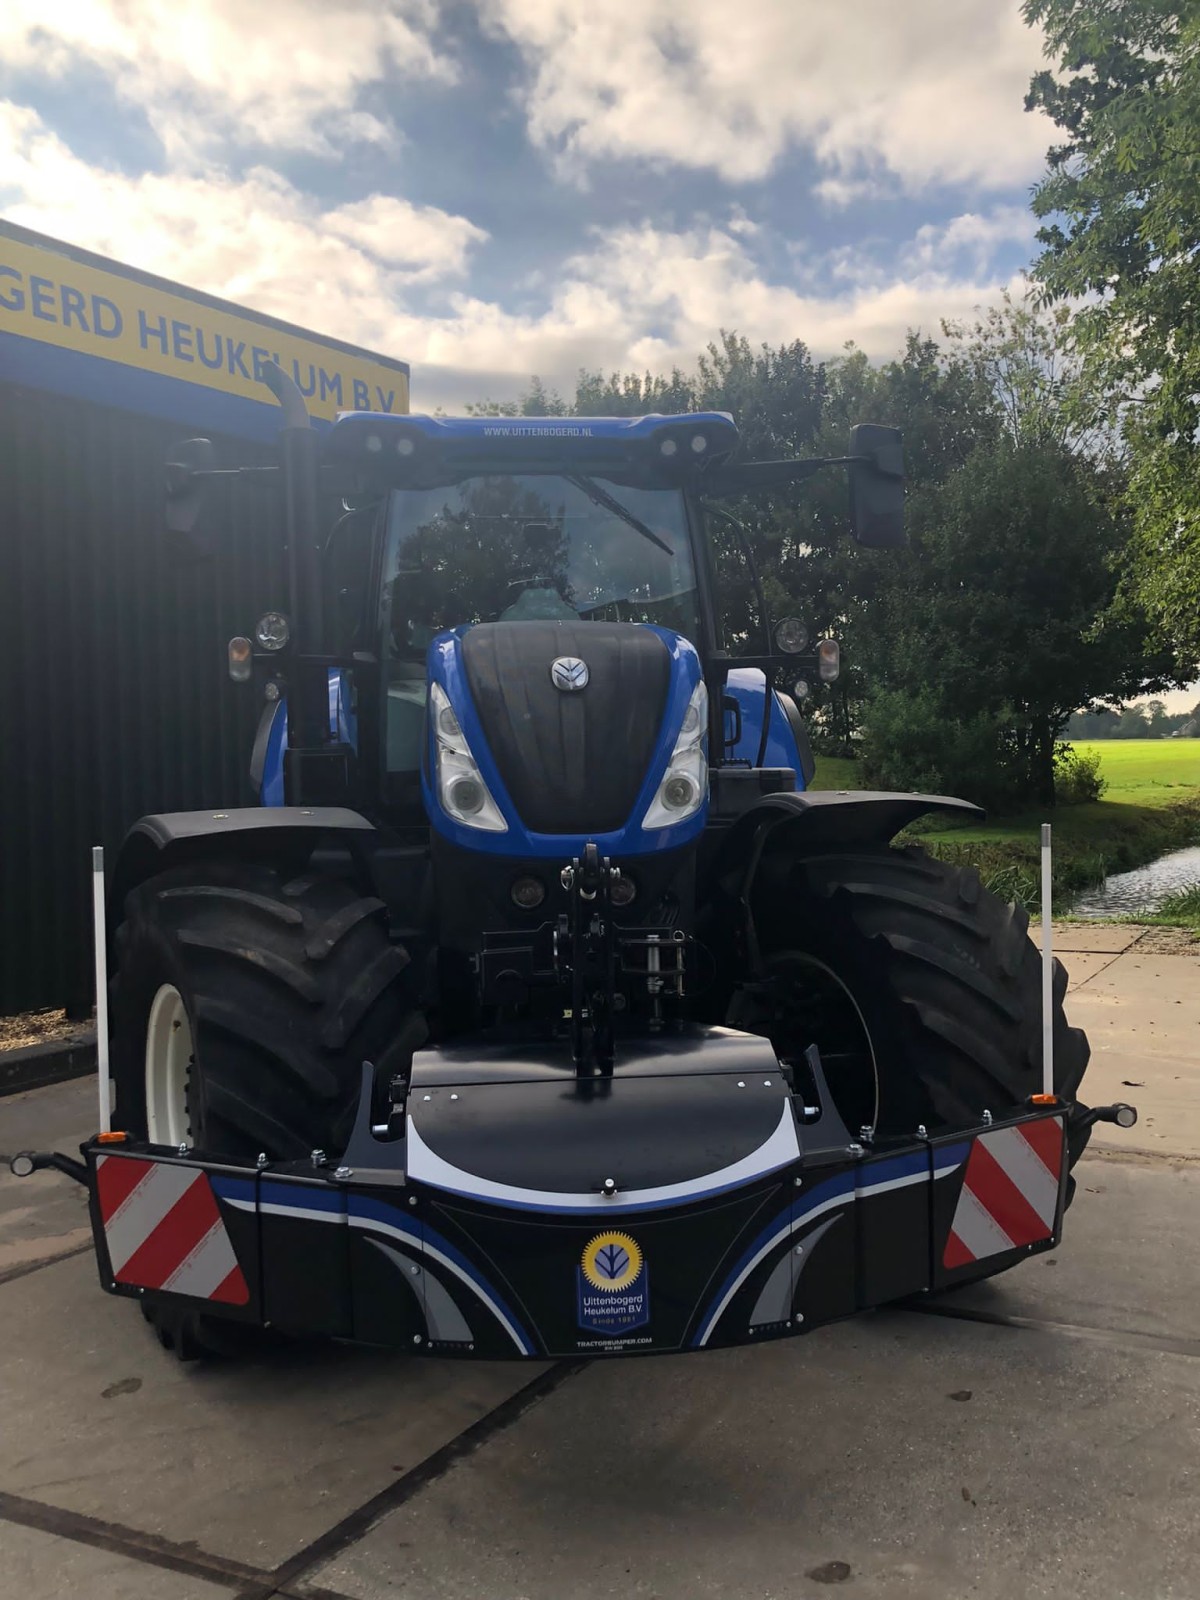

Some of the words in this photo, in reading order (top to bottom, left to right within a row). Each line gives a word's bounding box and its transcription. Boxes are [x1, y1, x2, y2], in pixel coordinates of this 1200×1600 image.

[0, 265, 124, 339] GERD
[483, 427, 594, 437] WWW.UITTENBOGERD.NL
[583, 1294, 643, 1307] Uittenbogerd
[584, 1305, 626, 1316] Heukelum
[576, 1337, 653, 1347] TRACTORBUMPER.COM
